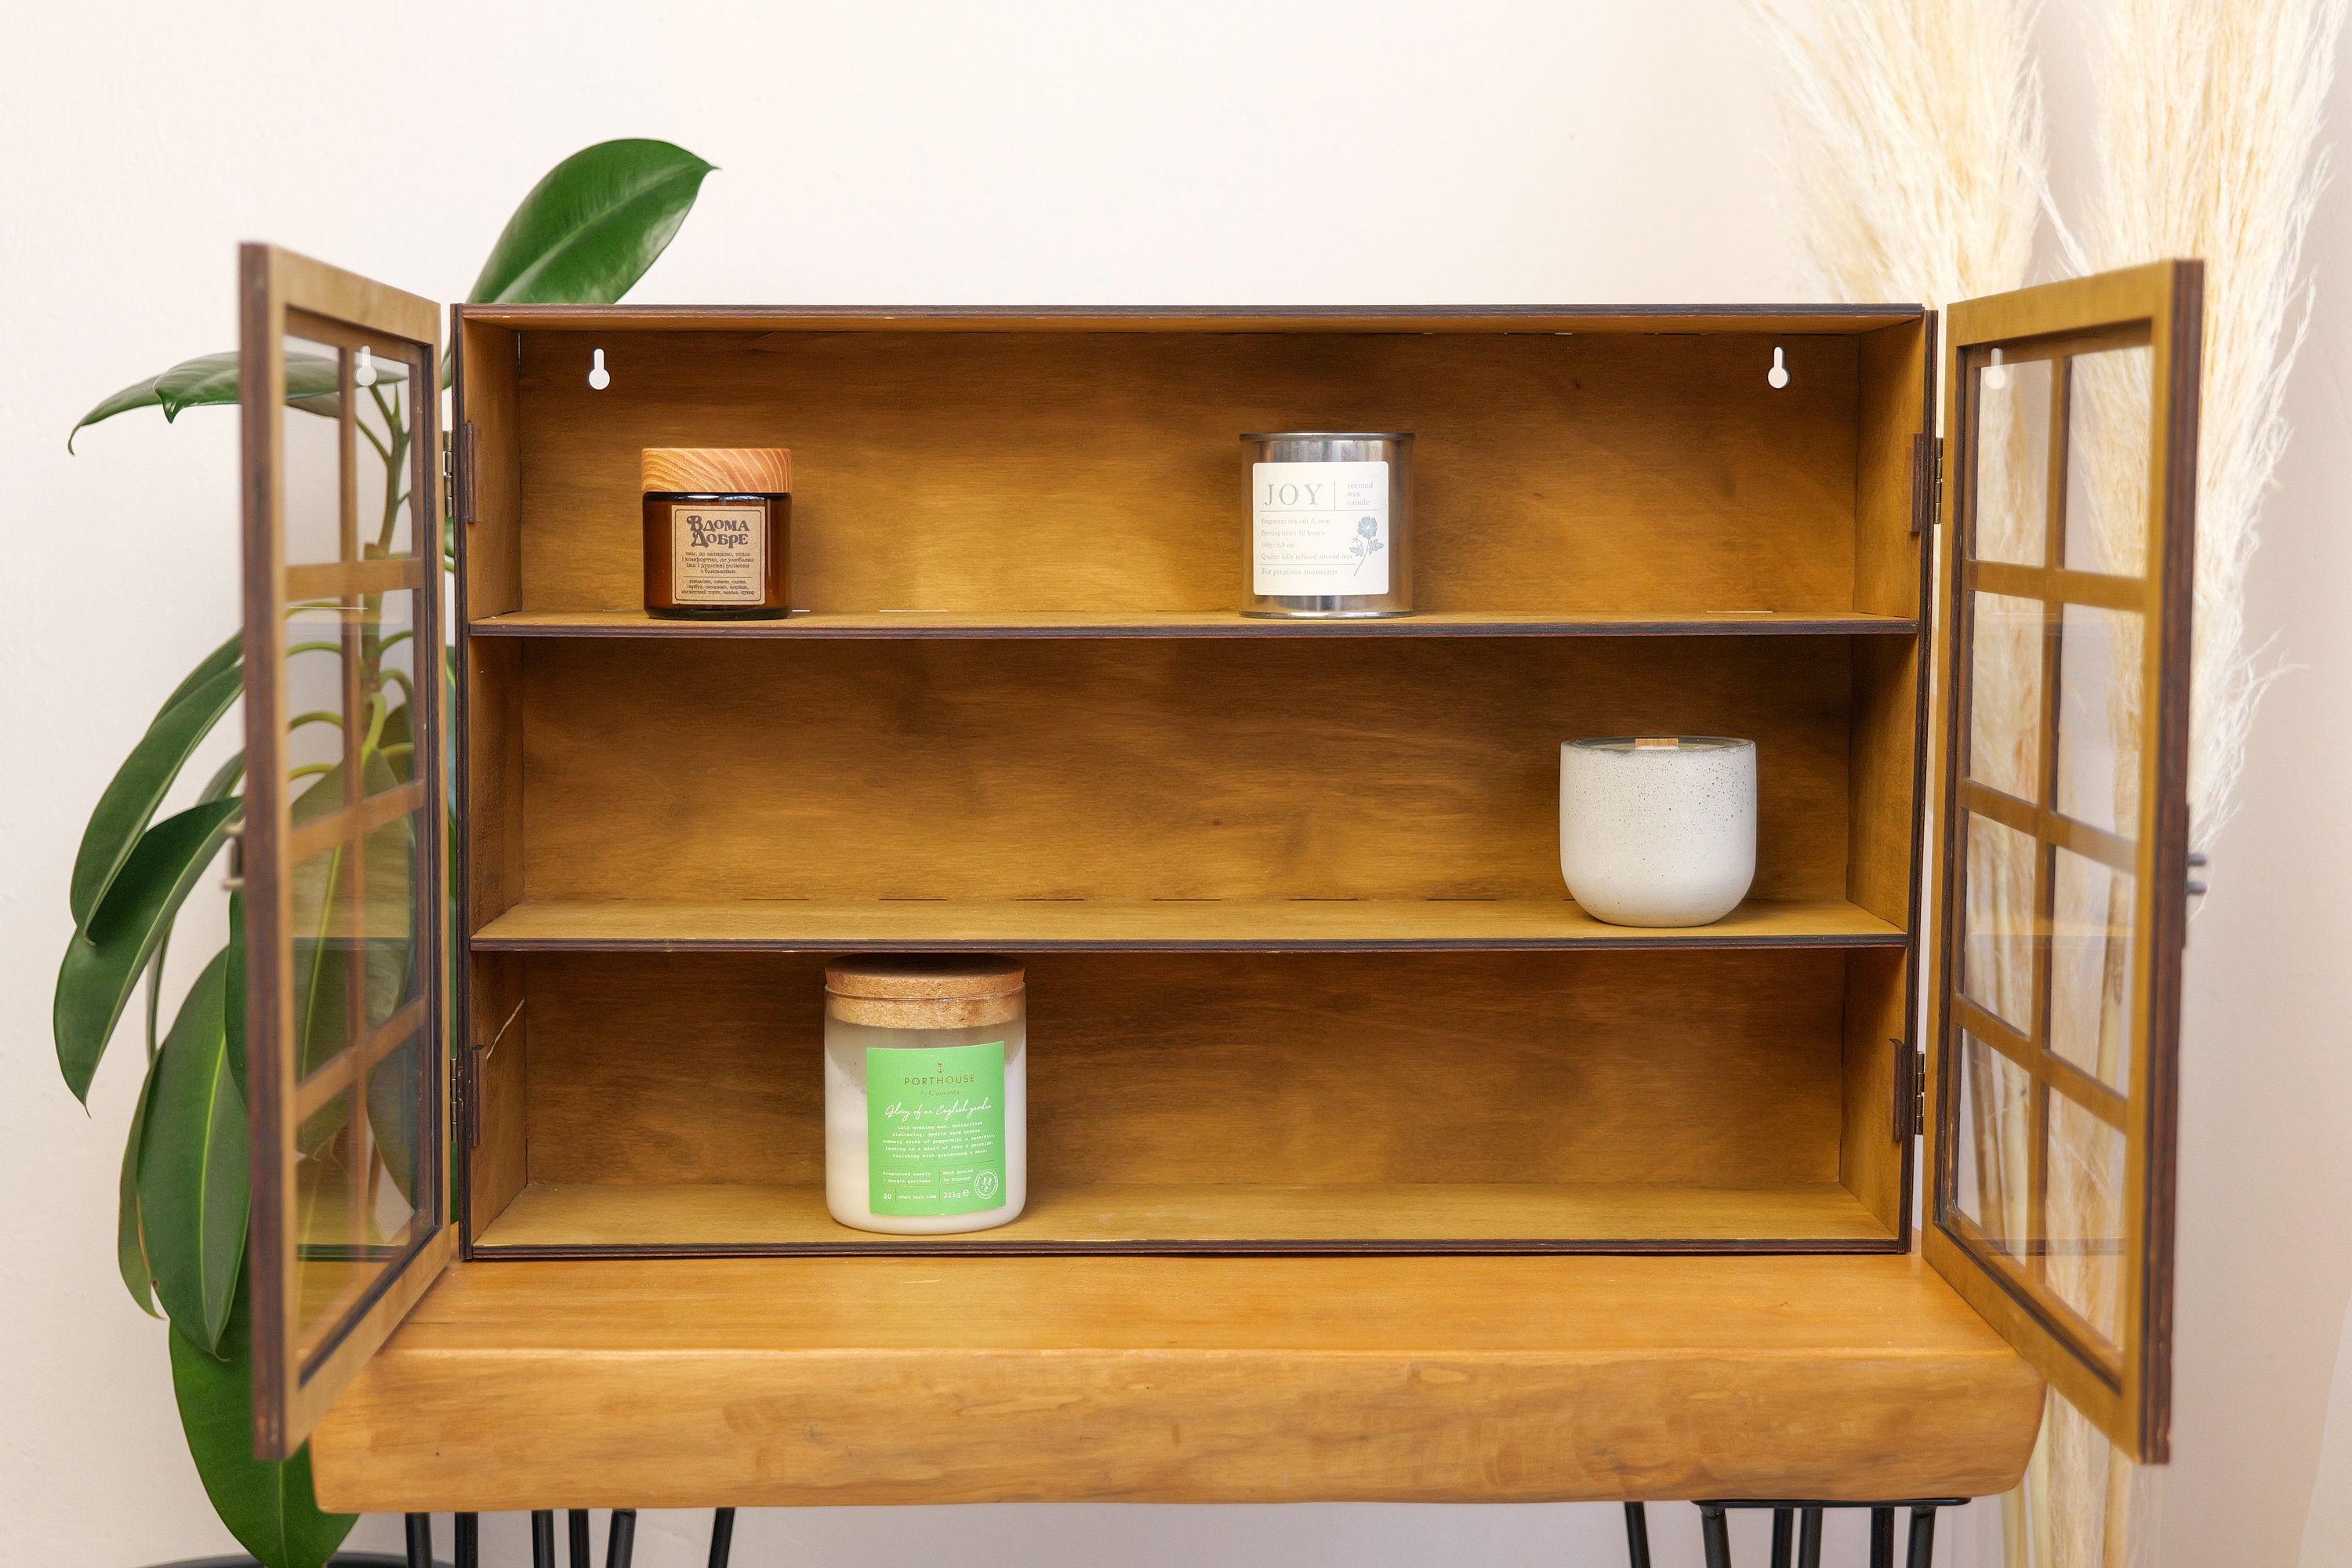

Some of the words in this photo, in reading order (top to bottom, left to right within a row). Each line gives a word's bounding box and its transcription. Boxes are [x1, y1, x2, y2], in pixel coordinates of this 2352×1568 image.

[1265, 484, 1323, 506] JOY
[905, 1074, 975, 1085] PORTHOUSE
[884, 1102, 911, 1122] Glory
[913, 1103, 923, 1120] of
[935, 1098, 967, 1120] English
[967, 1096, 992, 1119] garden
